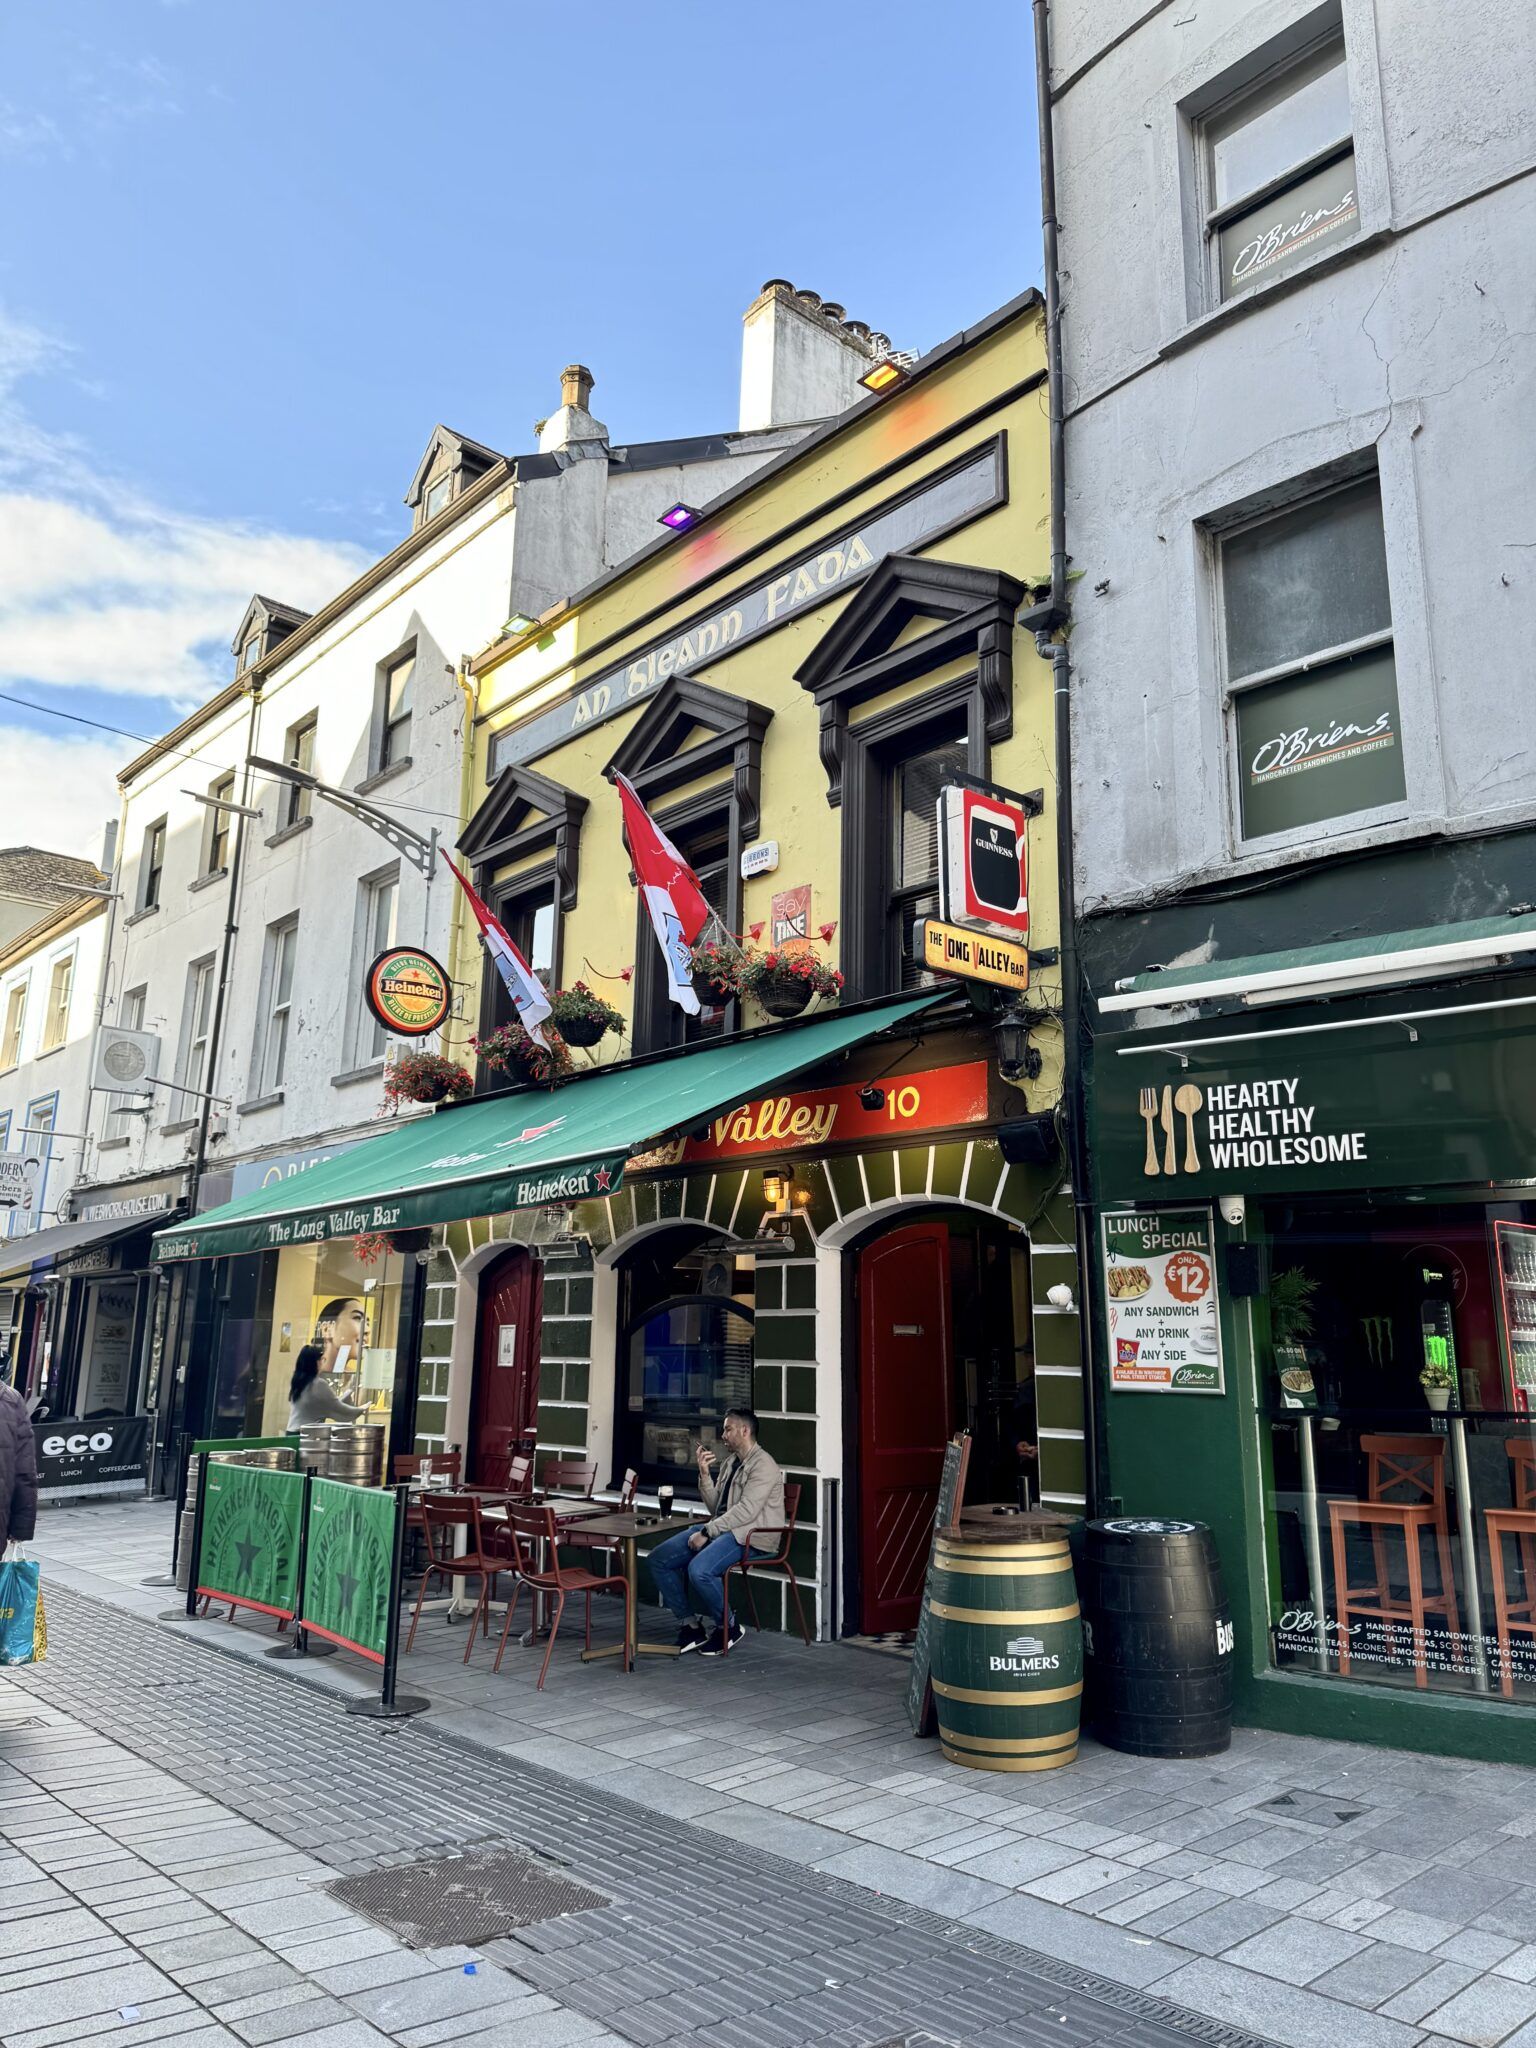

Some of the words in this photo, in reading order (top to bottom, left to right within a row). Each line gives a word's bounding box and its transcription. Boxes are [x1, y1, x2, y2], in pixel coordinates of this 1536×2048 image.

[1232, 190, 1354, 276] O'Briens
[1236, 257, 1276, 283] HANDCRAFTED
[1277, 235, 1315, 260] SANDWICHES
[1316, 227, 1329, 238] AND
[1329, 214, 1352, 230] COFFEE
[1252, 712, 1390, 774] O'Briens
[1257, 763, 1302, 783] HANDCRAFTED
[1303, 752, 1346, 769] SANDWICHES
[1347, 747, 1361, 757] AND
[1362, 739, 1388, 752] COFFEE
[975, 837, 1014, 859] GUINNESS
[776, 914, 805, 943] TIME
[929, 930, 942, 946] THE
[944, 932, 970, 963] LONG
[972, 941, 1010, 973] VALLEY
[1010, 962, 1025, 978] BAR
[384, 980, 441, 1000] Heineken
[1207, 1078, 1299, 1112] HEARTY
[714, 1097, 839, 1147] Valley
[887, 1086, 920, 1120] 10
[1208, 1106, 1315, 1140] HEALTHY
[1209, 1132, 1368, 1169] WHOLESOME
[516, 1174, 590, 1205] Heineken
[157, 1241, 190, 1260] Heineken
[268, 1223, 290, 1243] The
[292, 1219, 326, 1240] Long
[329, 1210, 370, 1234] Valley
[371, 1205, 401, 1226] Bar
[1108, 1217, 1160, 1234] LUNCH
[1142, 1231, 1207, 1249] SPECIAL
[1177, 1256, 1198, 1265] ONLY
[1124, 1307, 1144, 1317] ANY
[1146, 1306, 1199, 1317] SANDWICH
[1135, 1328, 1155, 1339] ANY
[1158, 1328, 1190, 1339] DRINK
[1141, 1350, 1161, 1361] ANY
[1164, 1350, 1187, 1361] SIDE
[1176, 1369, 1214, 1381] O'Briens
[42, 1432, 113, 1455] eco
[98, 1463, 141, 1474] COFFEE/CAKES
[254, 1487, 288, 1586] ORIGINAL
[1279, 1609, 1362, 1634] O'Briens
[1365, 1622, 1431, 1636] HANDCRAFTED
[1433, 1630, 1500, 1646] SANDWICHES,
[1366, 1632, 1412, 1645] SPECIALITY
[1414, 1638, 1438, 1649] TEAS,
[1439, 1641, 1483, 1654] SCONES,
[989, 1654, 1060, 1671] BULMERS
[1277, 1632, 1323, 1645] SPECIALITY
[1327, 1639, 1350, 1649] TEAS,
[1352, 1642, 1390, 1654] SCONES,
[1391, 1646, 1448, 1662] SMOOTHIES,
[1491, 1659, 1526, 1671] CAKES,
[1278, 1642, 1340, 1656] HANDCRAFTED
[1343, 1650, 1404, 1666] SANDWICHES,
[1406, 1658, 1437, 1669] TRIPLE
[1439, 1663, 1485, 1677] DECKERS,
